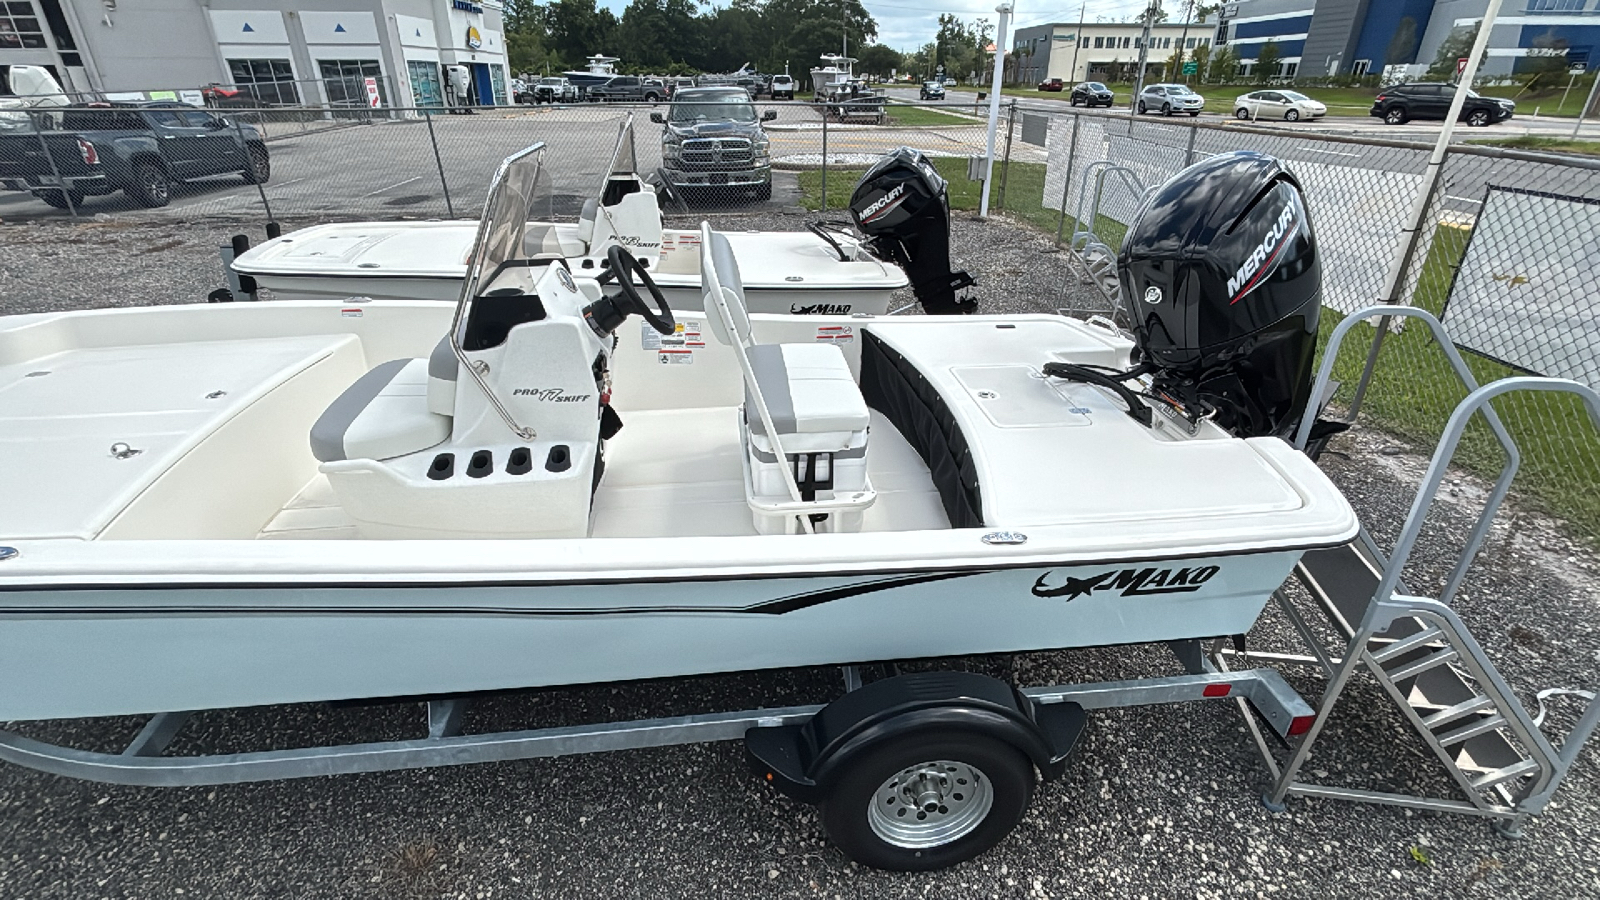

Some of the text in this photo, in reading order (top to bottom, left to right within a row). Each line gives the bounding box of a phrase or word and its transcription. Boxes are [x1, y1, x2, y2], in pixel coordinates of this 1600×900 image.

[858, 181, 906, 221] MERCURY
[1226, 195, 1297, 298] MERCURY
[811, 303, 852, 316] MAKO
[512, 388, 539, 396] PRO
[555, 394, 591, 403] SKIFF
[1157, 402, 1178, 420] MAKO
[1092, 564, 1221, 597] MAKO
